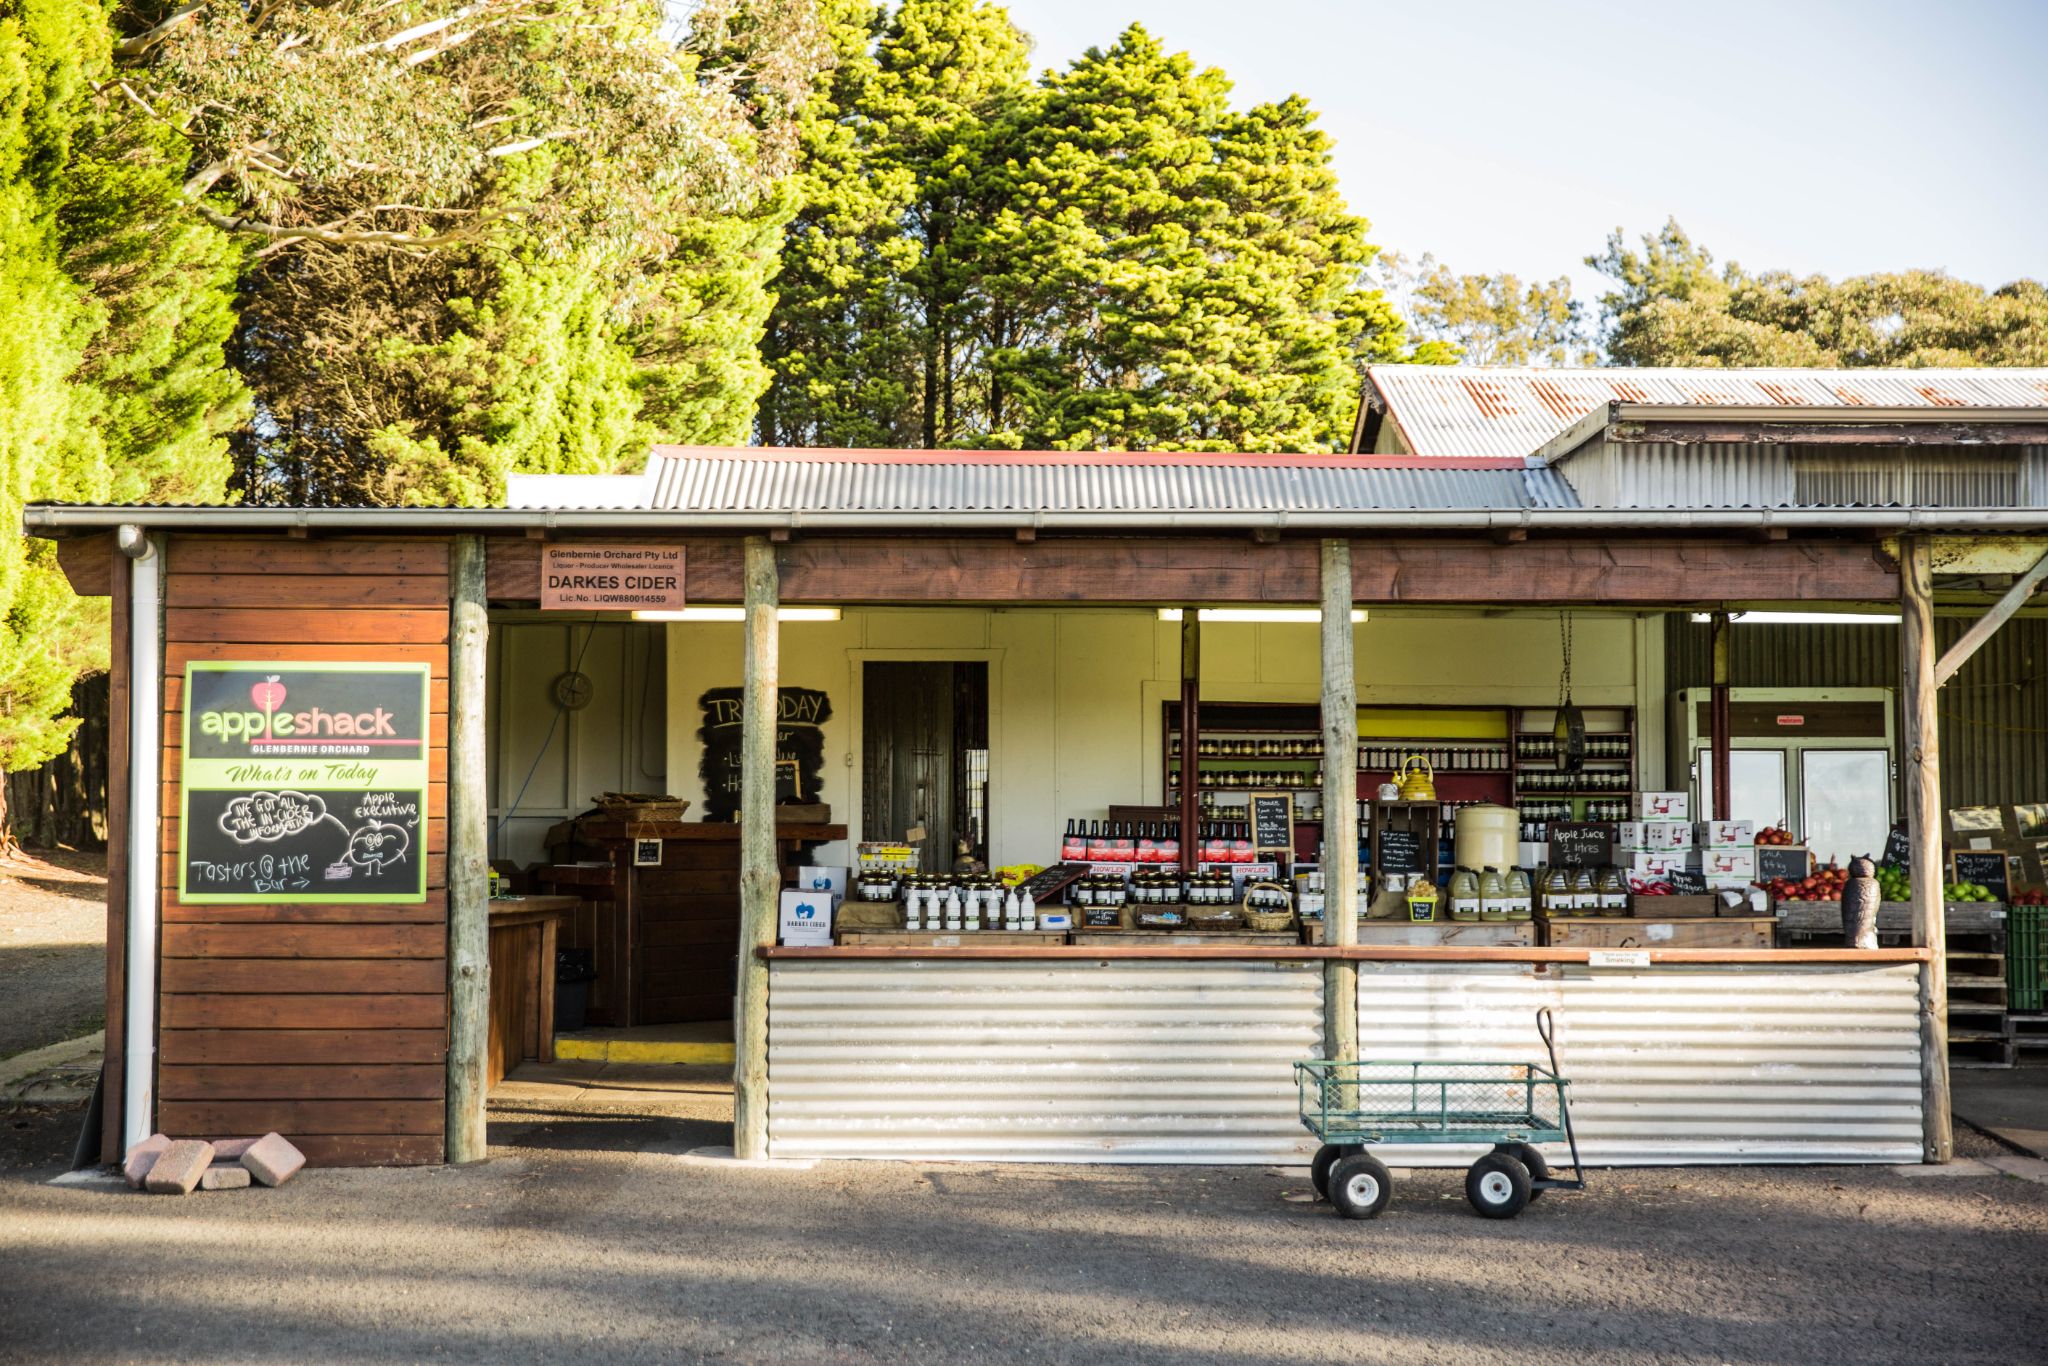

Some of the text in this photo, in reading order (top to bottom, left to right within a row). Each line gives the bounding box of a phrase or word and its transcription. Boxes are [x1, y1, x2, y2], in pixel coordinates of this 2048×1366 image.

[550, 550, 601, 559] Glenbernie
[604, 551, 642, 559] Orchard
[645, 552, 660, 560] Pty
[548, 576, 677, 589] DARKES CIDER
[252, 745, 370, 754] GLENBERNIE ORCHARD
[225, 763, 378, 786] What's on Today
[256, 799, 275, 811] GOT
[281, 797, 296, 809] ALL
[363, 792, 395, 804] Apple
[233, 817, 256, 830] THE
[1554, 828, 1605, 843] Apple Juice
[1561, 841, 1600, 853] 2 litres
[190, 853, 310, 882] Tasters @ the
[1672, 871, 1693, 883] Apple
[255, 878, 290, 893] Bar
